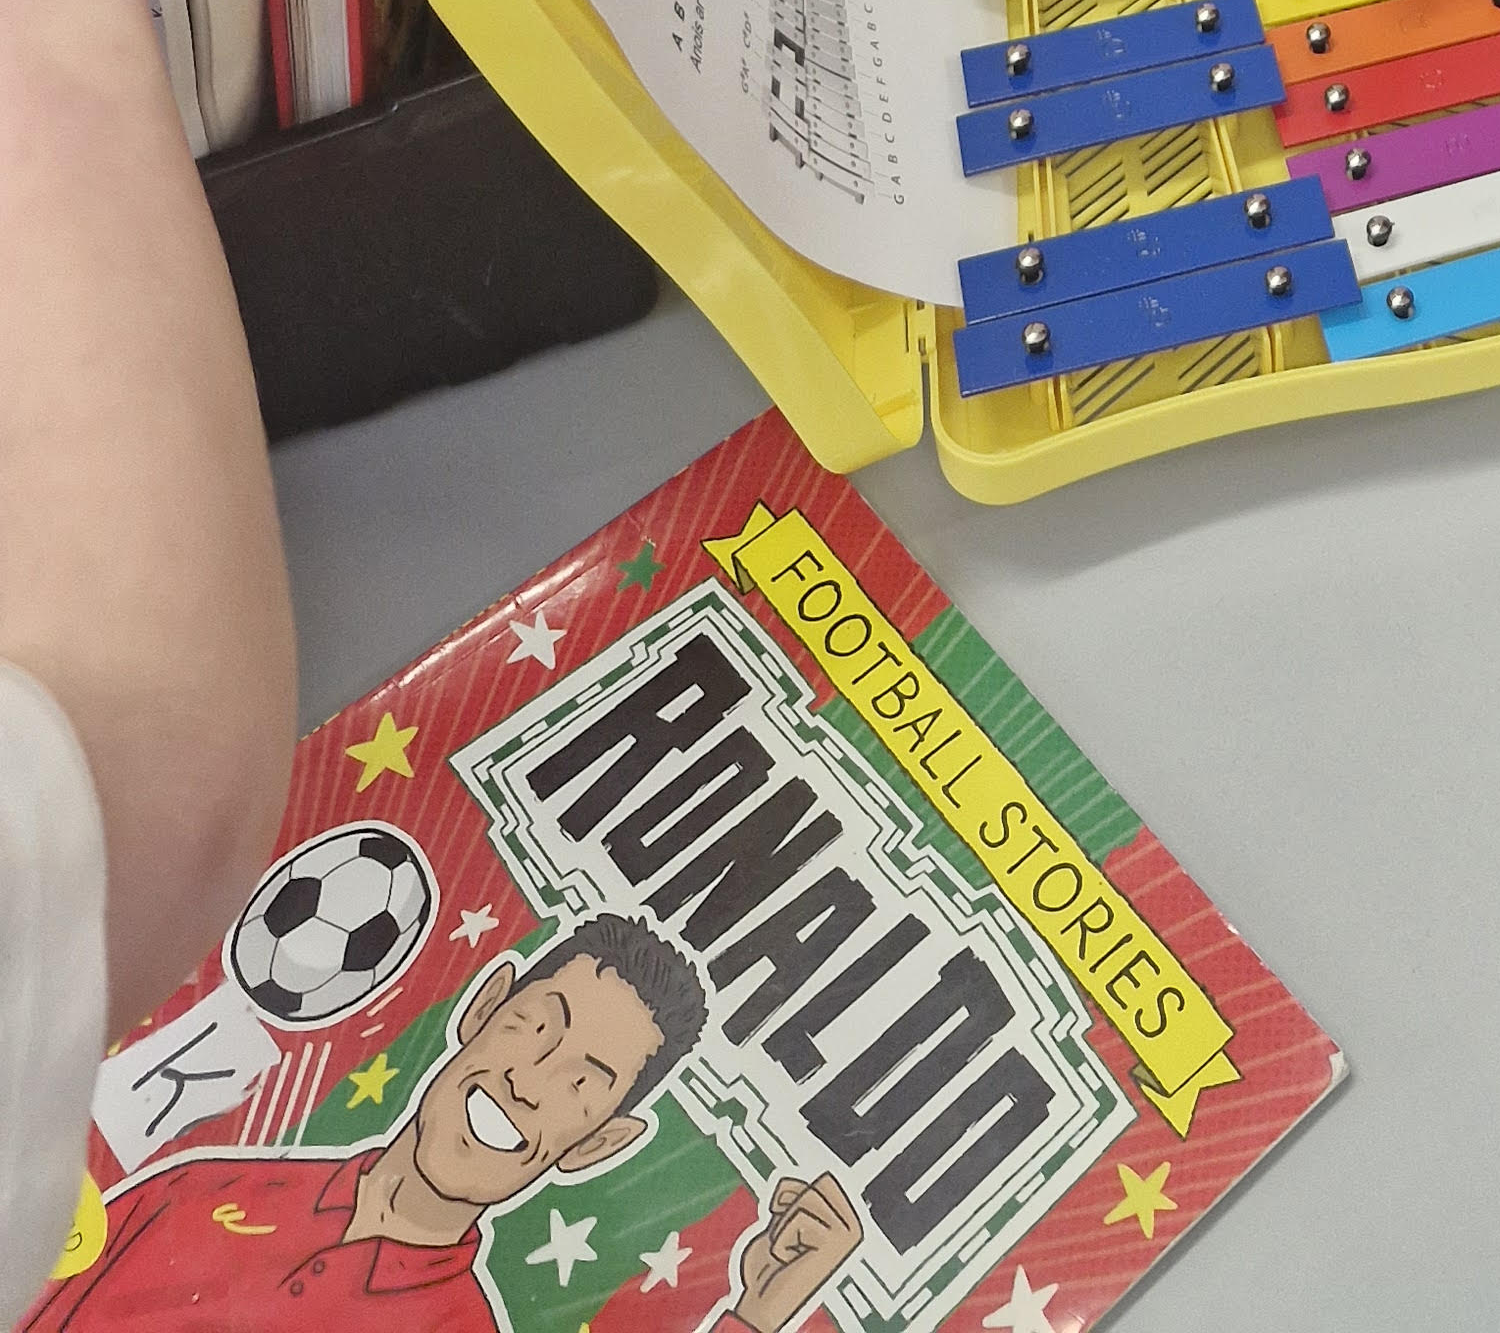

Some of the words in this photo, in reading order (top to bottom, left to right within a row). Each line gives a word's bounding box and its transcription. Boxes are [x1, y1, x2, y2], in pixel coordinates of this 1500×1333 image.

[673, 0, 686, 23] B
[863, 3, 874, 14] C
[866, 21, 877, 32] B
[671, 32, 683, 53] A
[869, 40, 880, 51] A
[689, 24, 704, 75] Anois
[872, 56, 883, 68] G
[876, 76, 887, 86] F
[878, 93, 890, 104] E
[881, 111, 893, 124] D
[884, 132, 896, 144] C
[887, 153, 899, 164] B
[890, 174, 901, 186] A
[893, 193, 905, 205] G
[771, 549, 983, 809] FOOTBALL
[978, 801, 1186, 1039] STORIES
[525, 632, 1057, 1256] RONALDO
[130, 1020, 236, 1138] K
